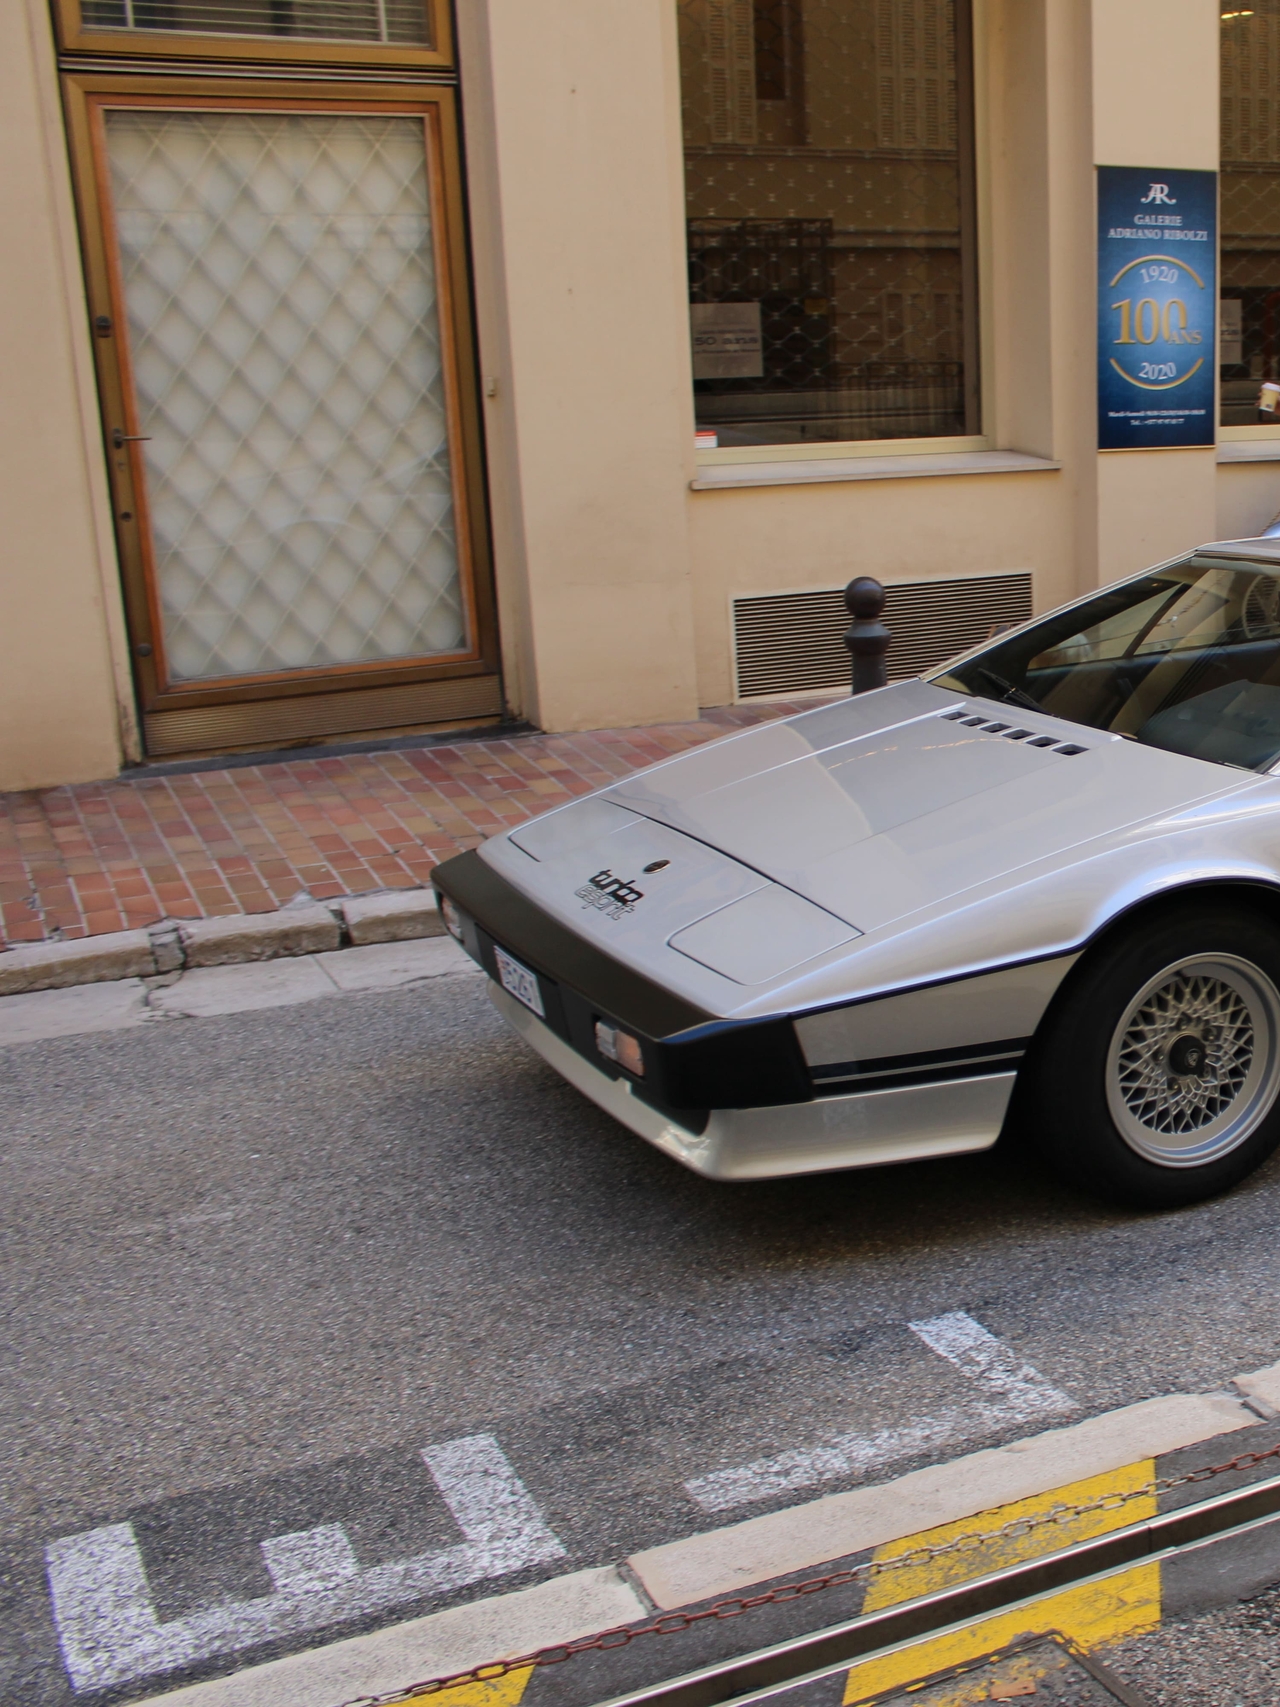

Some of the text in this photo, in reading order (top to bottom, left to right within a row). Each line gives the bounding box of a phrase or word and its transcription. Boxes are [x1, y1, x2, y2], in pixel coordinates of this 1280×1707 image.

[1133, 214, 1183, 226] GALERIE
[1107, 228, 1208, 241] ADRIANO RIBOLZI
[1140, 265, 1179, 284] 1920
[1111, 298, 1187, 346] 100
[1138, 362, 1177, 380] 2020
[588, 869, 645, 905] turbo
[574, 884, 636, 920] esprit
